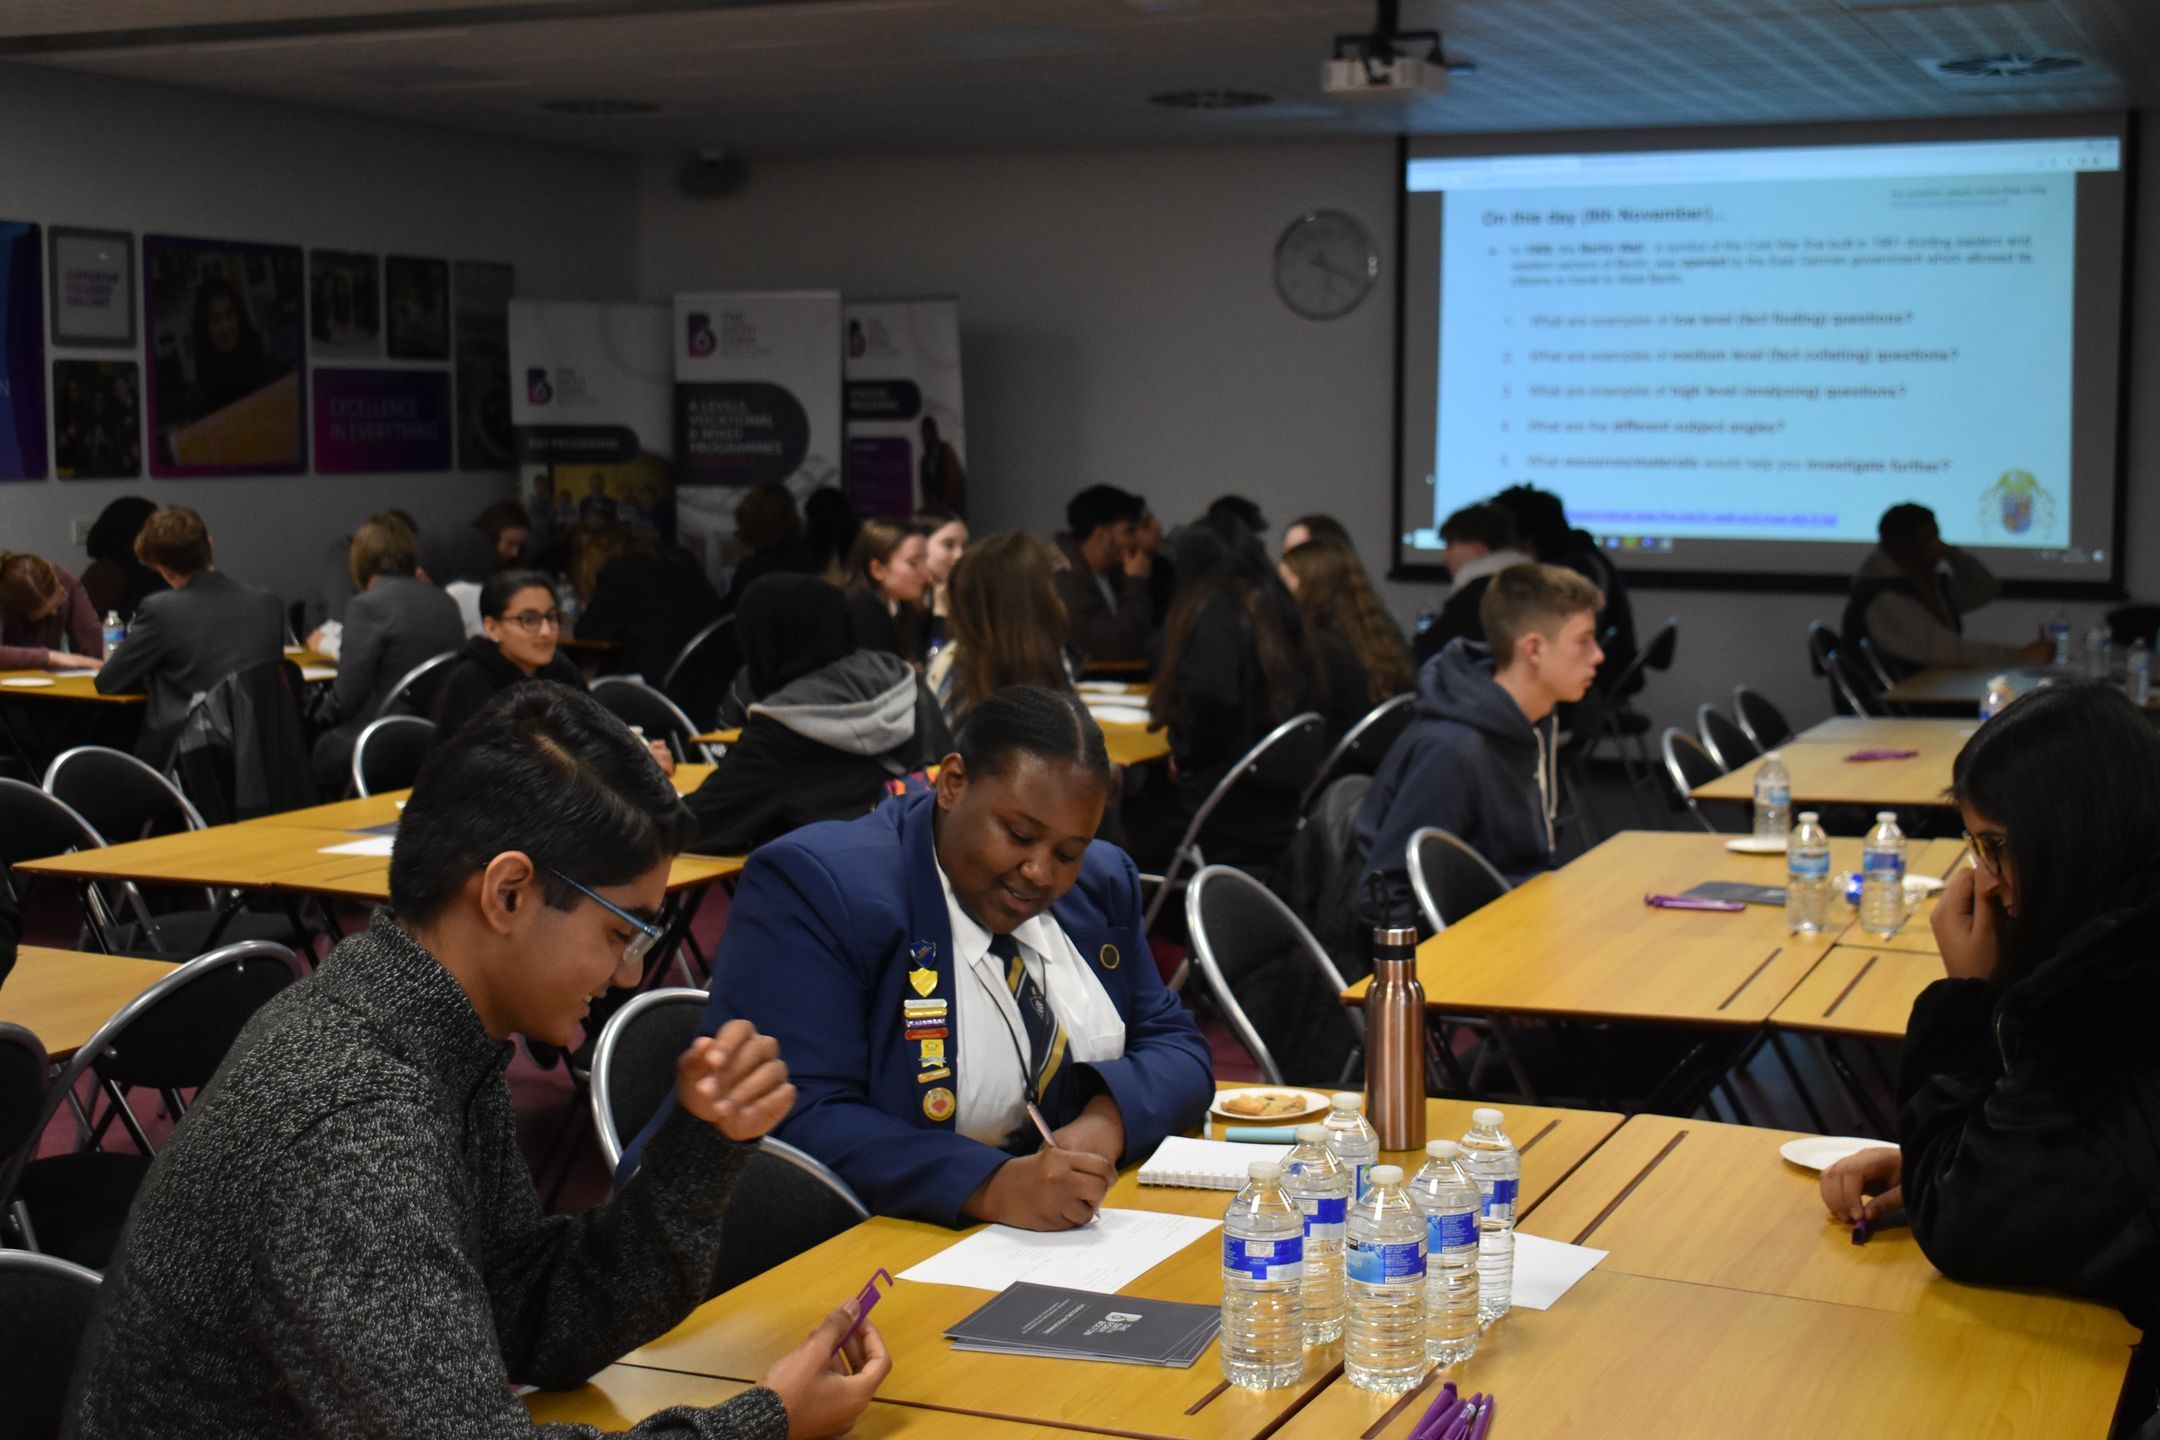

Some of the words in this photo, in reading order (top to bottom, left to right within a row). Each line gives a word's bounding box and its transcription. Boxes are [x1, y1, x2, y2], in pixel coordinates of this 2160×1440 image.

[1482, 209, 1504, 226] On
[1511, 208, 1542, 225] this
[1546, 208, 1576, 229] day
[2007, 234, 2032, 248] and
[1851, 253, 1923, 269] government
[1530, 314, 1562, 328] What
[1567, 316, 1586, 328] are
[1592, 314, 1651, 330] examples
[1673, 313, 1696, 327] low
[1702, 313, 1733, 327] level
[1833, 309, 1915, 328] questions?
[1529, 350, 1562, 363] What
[1567, 352, 1585, 363] are
[1591, 350, 1650, 365] examples
[1672, 348, 1727, 362] medium
[1732, 348, 1763, 362] level
[1877, 345, 1960, 364] questions?
[1528, 385, 1561, 398] What
[1566, 387, 1584, 398] are
[1590, 385, 1649, 401] examples
[1671, 383, 1701, 402] high
[1706, 384, 1737, 398] level
[1826, 382, 1908, 401] questions?
[329, 396, 418, 419] EXCELLENCE
[688, 413, 776, 429] VOCATIONAL
[1527, 419, 1560, 433] What
[1565, 421, 1584, 433] are
[1613, 417, 1670, 433] different
[1674, 419, 1725, 436] subject
[1729, 418, 1787, 437] angles?
[329, 421, 346, 441] IN
[350, 421, 438, 443] EVERYTHING
[702, 428, 745, 443] MIXED
[1526, 454, 1559, 468] What
[1807, 456, 1886, 476] investigate
[1889, 455, 1953, 475] further?
